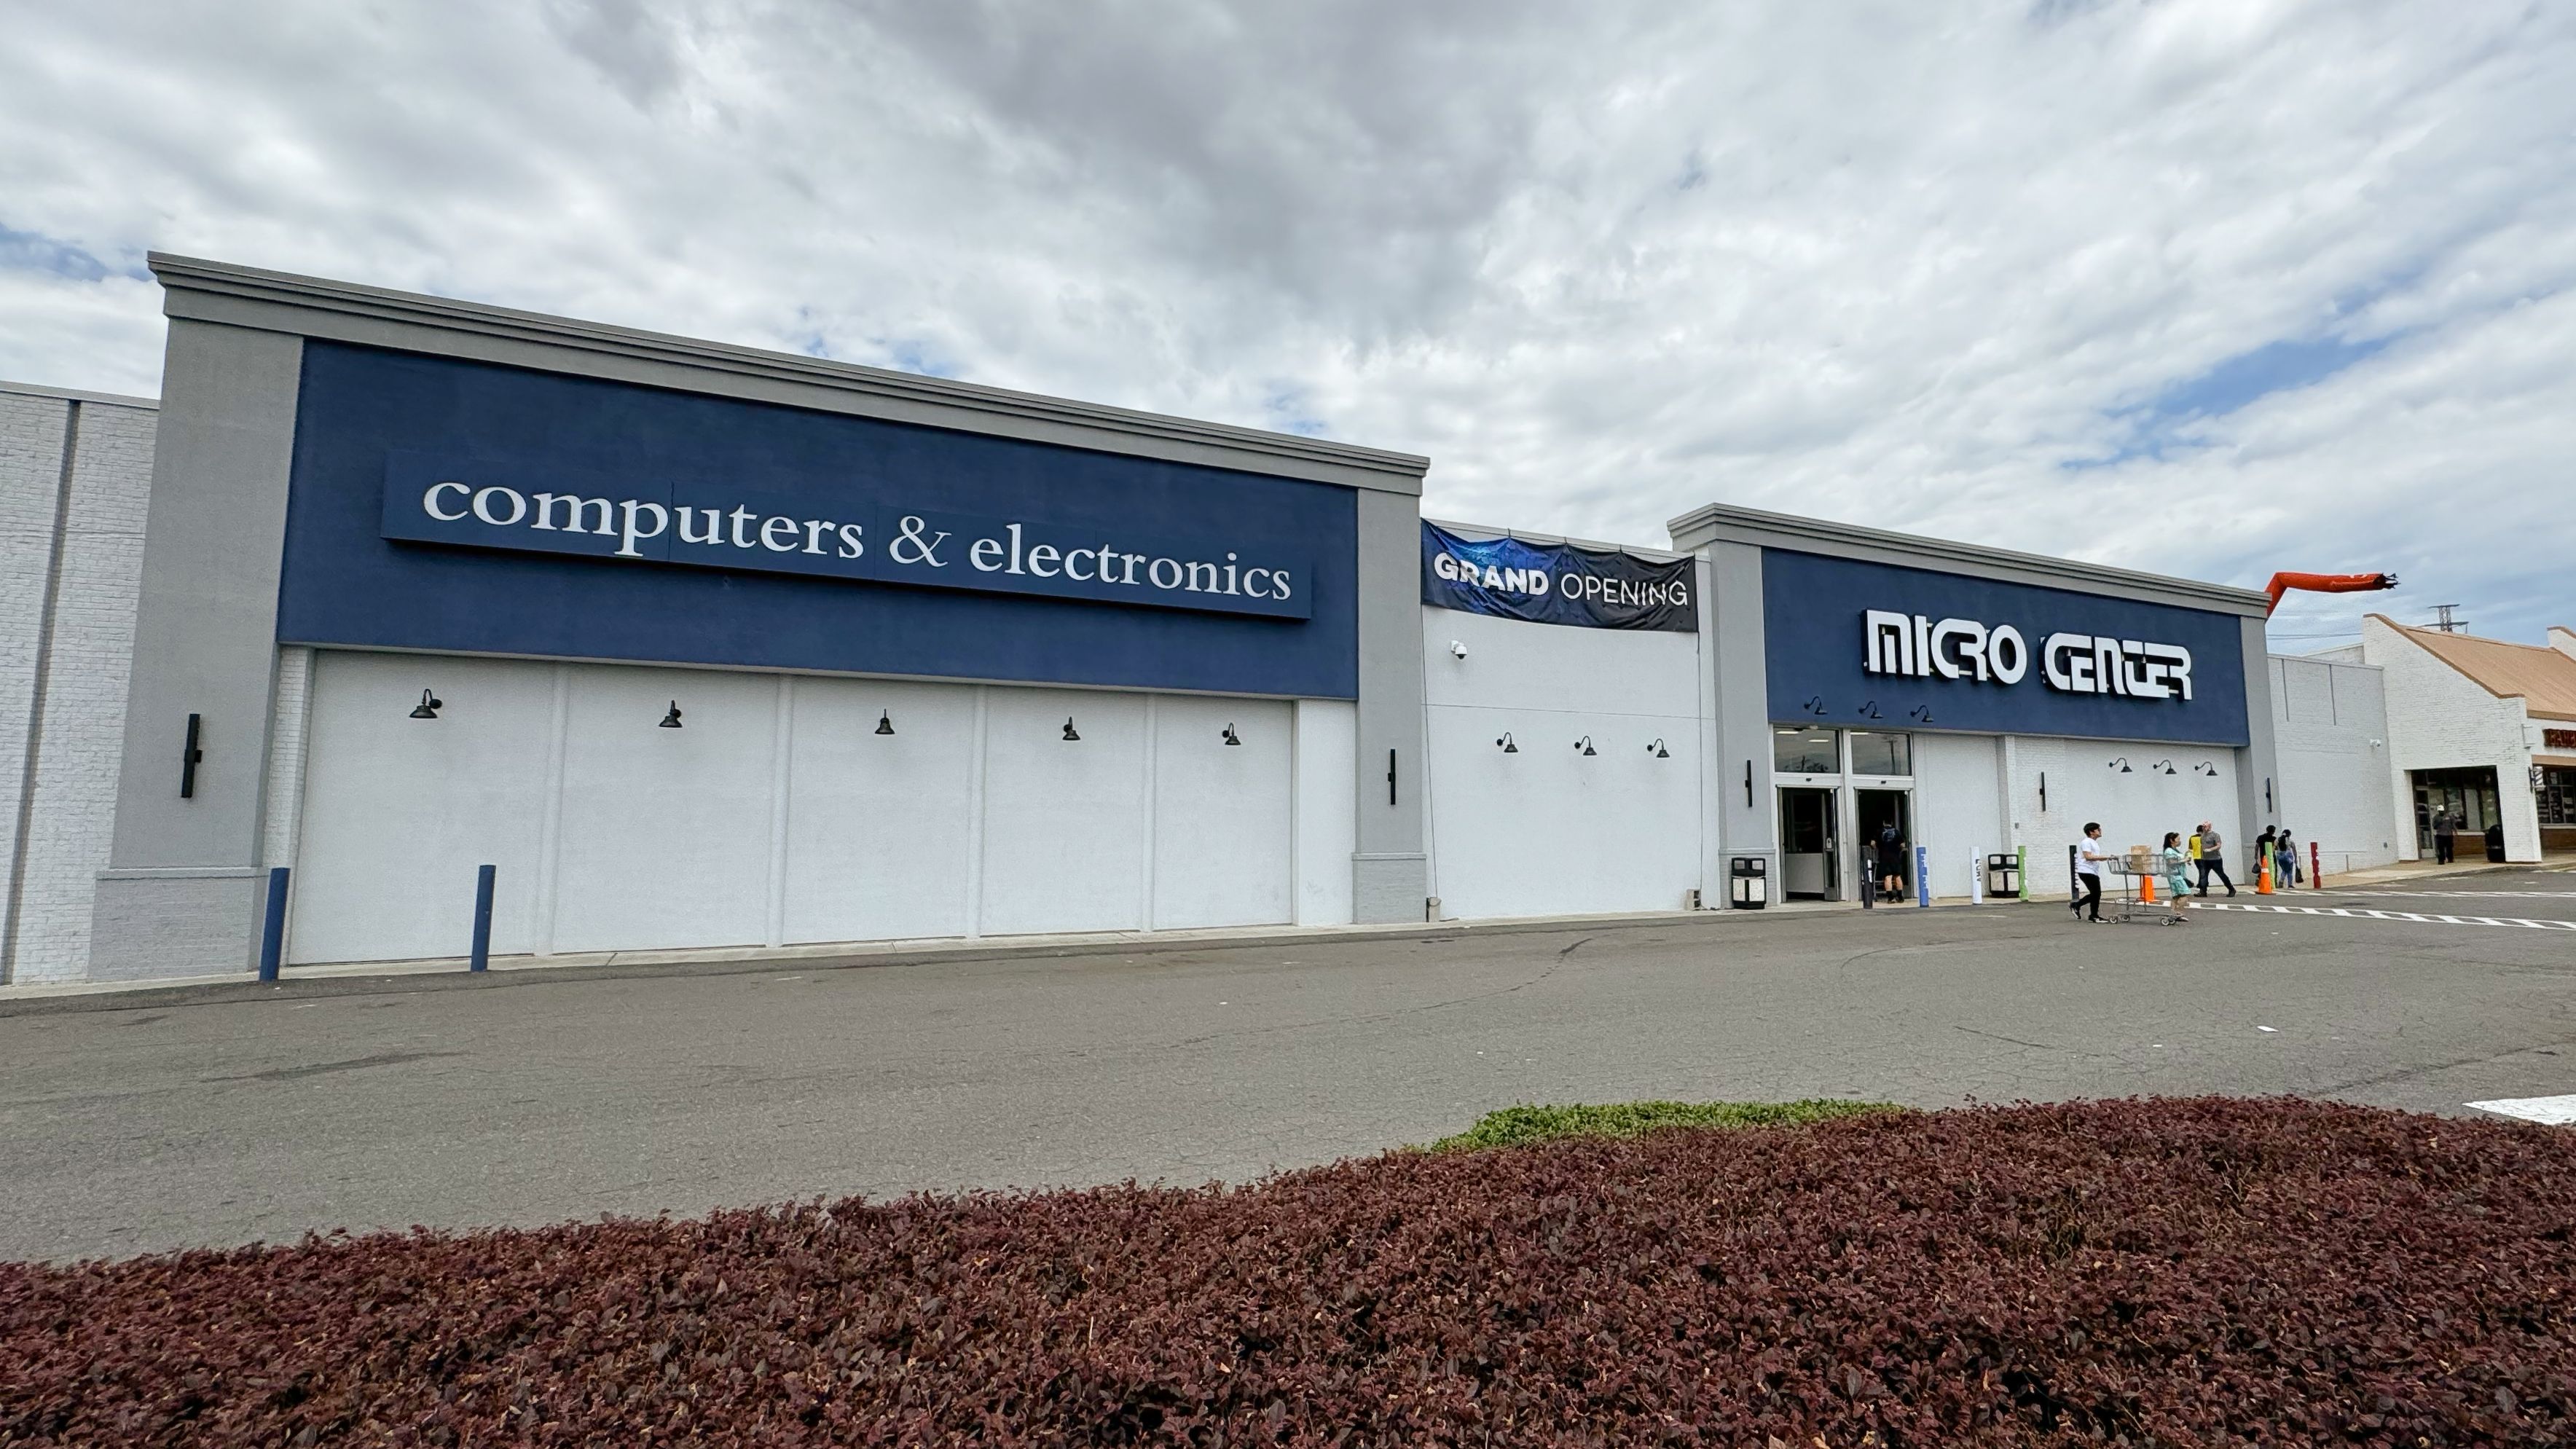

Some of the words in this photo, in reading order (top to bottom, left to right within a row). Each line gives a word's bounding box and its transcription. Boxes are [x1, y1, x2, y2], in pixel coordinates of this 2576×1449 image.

[424, 482, 864, 557] computers
[889, 516, 951, 568] &
[970, 523, 1292, 600] electronics
[1434, 552, 1550, 596] GRAND
[1560, 573, 1688, 606] OPENING
[1866, 609, 2027, 684] MICRO
[2044, 632, 2192, 700] CENTER
